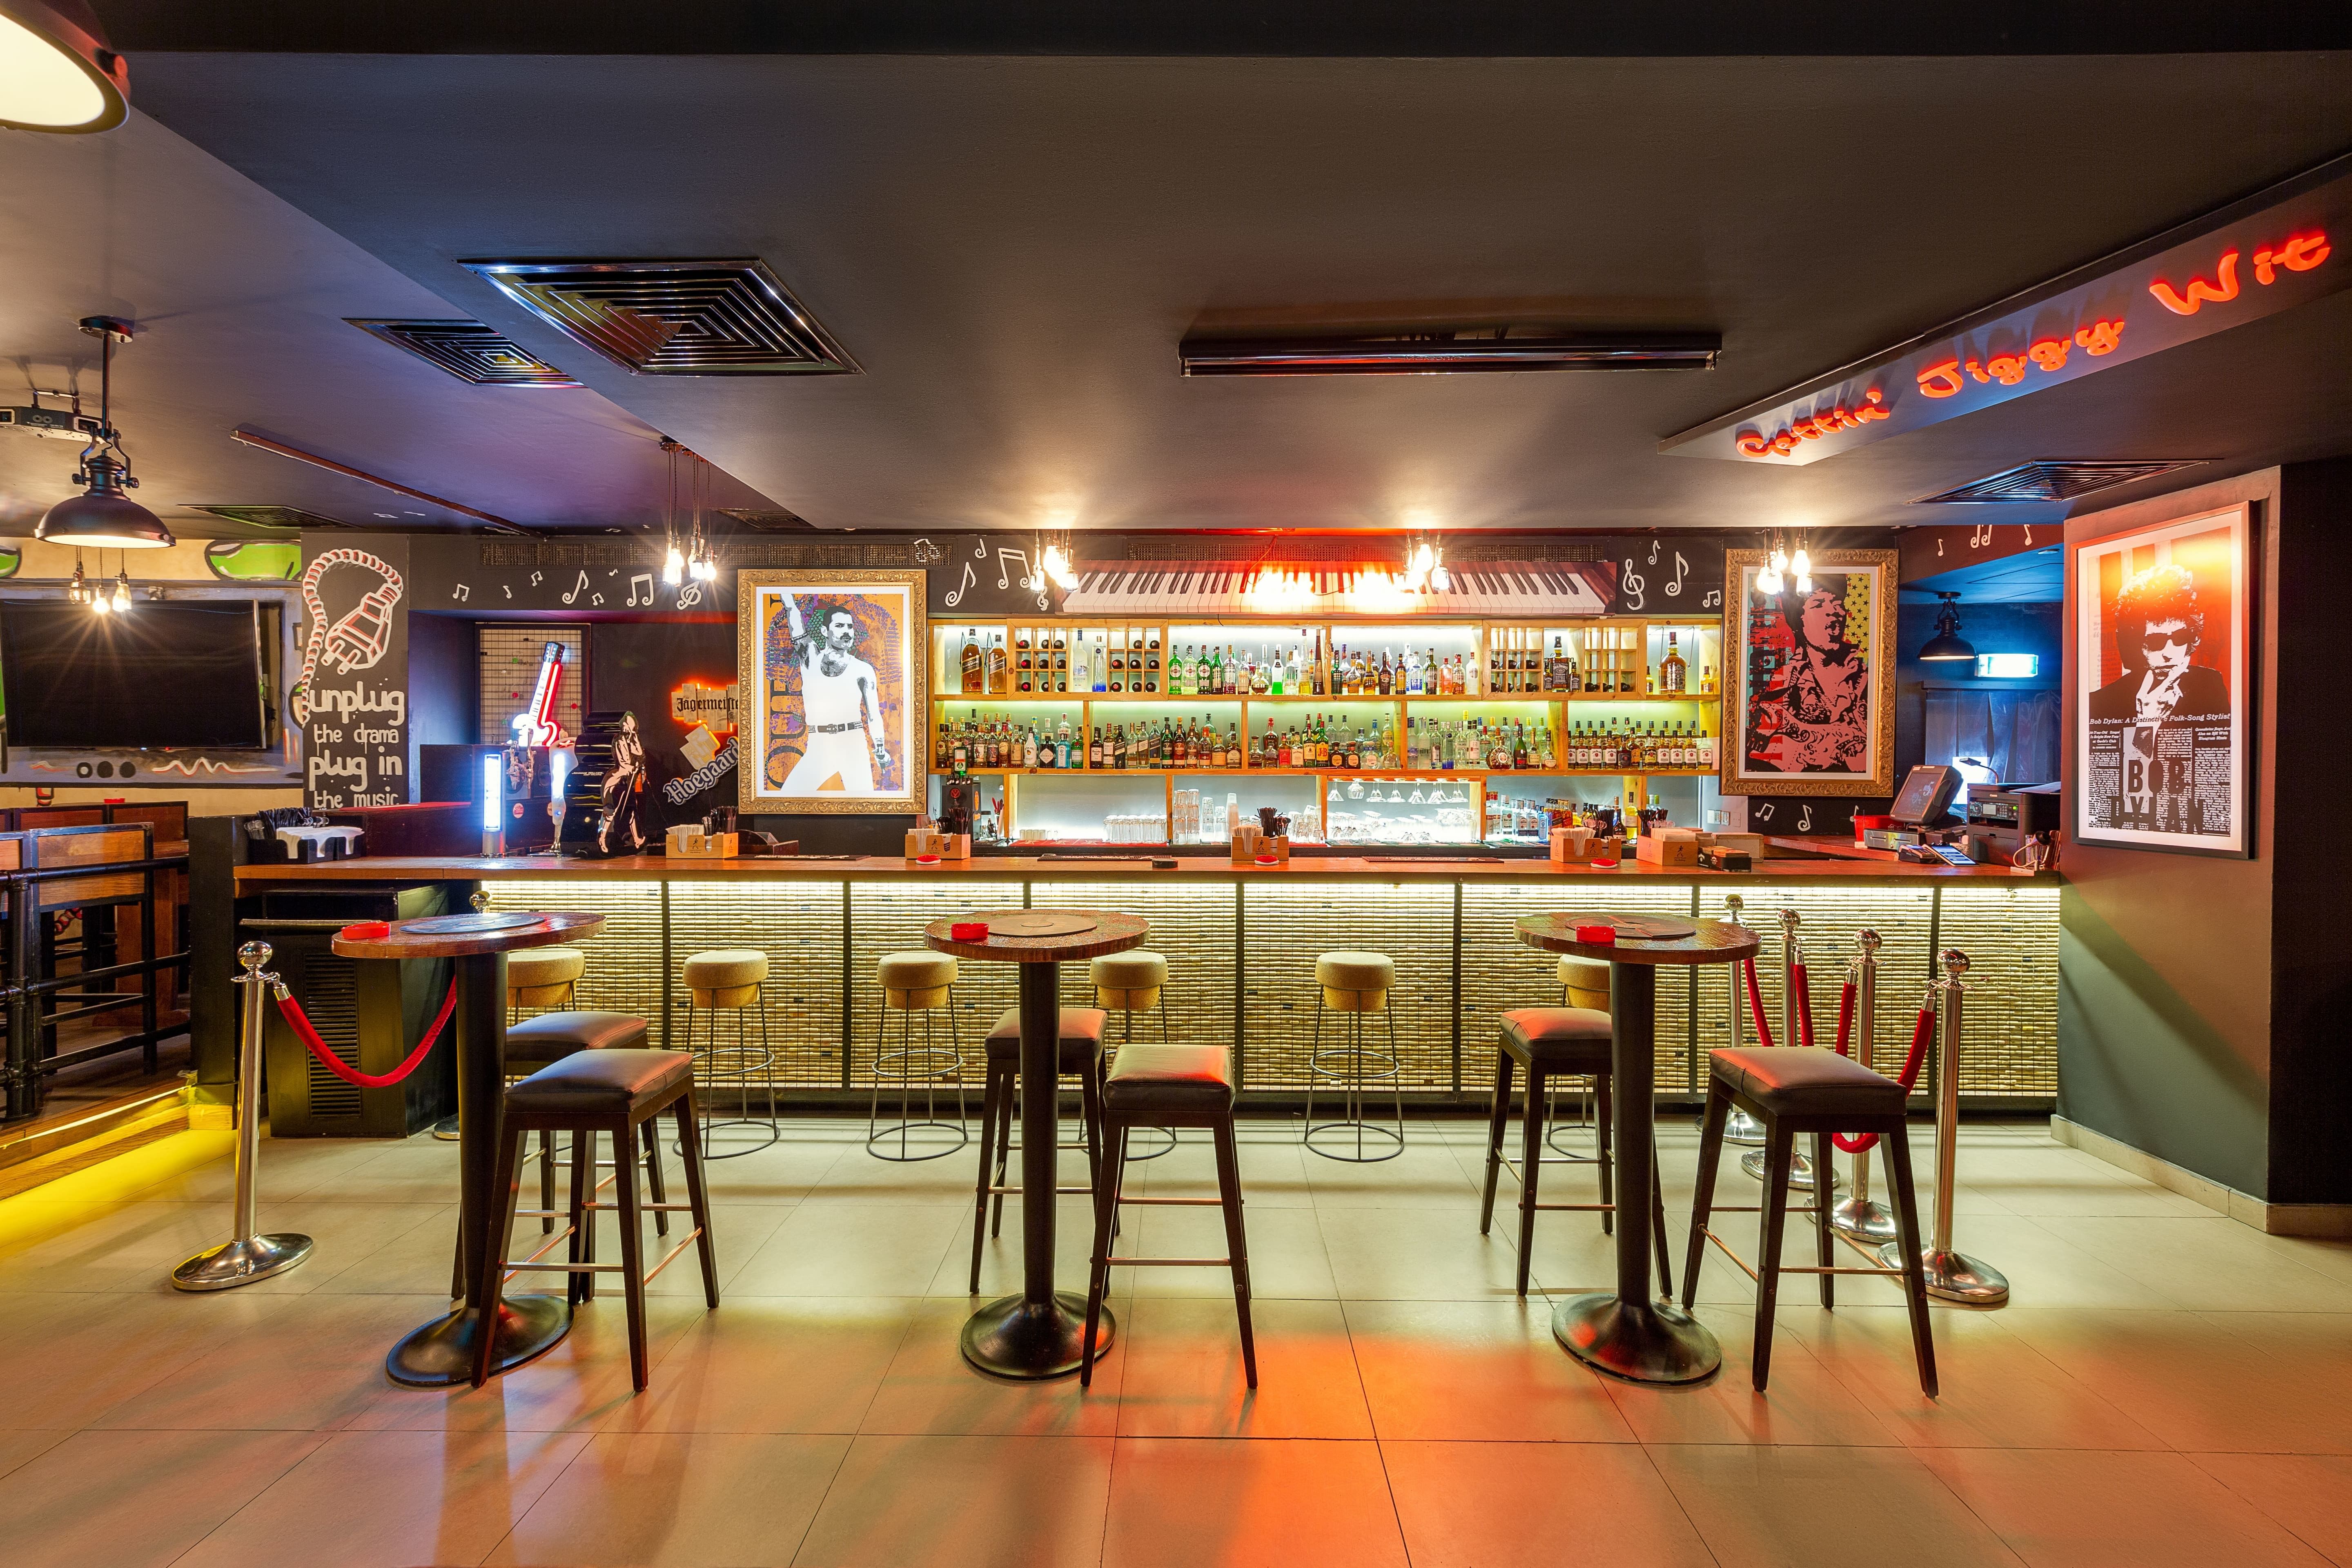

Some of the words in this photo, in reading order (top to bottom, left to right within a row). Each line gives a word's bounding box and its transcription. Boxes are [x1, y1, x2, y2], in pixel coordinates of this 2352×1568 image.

[1916, 321, 2125, 399] Jiggy
[2149, 234, 2331, 316] Wit
[308, 681, 405, 726] unplug
[314, 723, 343, 744] the
[354, 723, 399, 744] drama
[308, 749, 368, 792] plug
[379, 746, 403, 775] in
[2128, 760, 2185, 794] BOB
[314, 791, 343, 808] the
[354, 787, 399, 807] music
[2110, 796, 2204, 833] DYLAN
